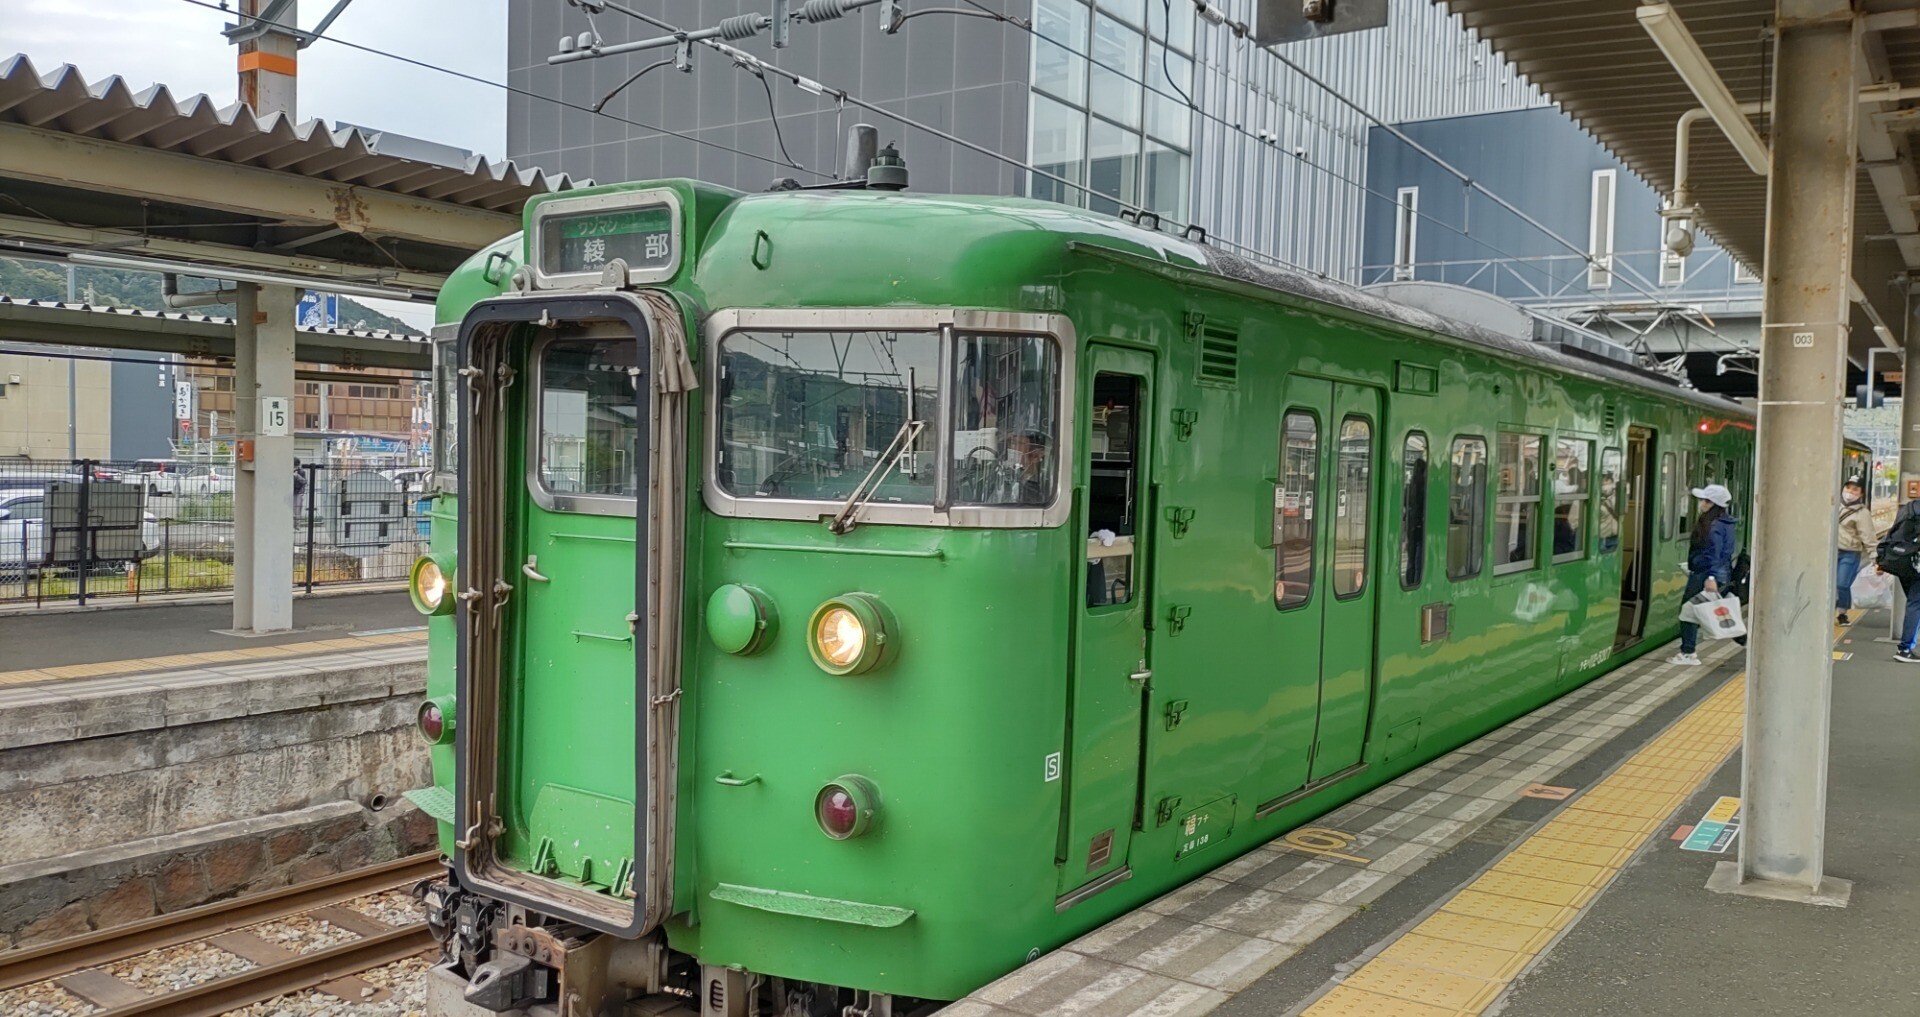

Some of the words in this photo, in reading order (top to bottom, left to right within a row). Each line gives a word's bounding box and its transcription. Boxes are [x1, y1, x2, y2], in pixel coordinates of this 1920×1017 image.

[577, 221, 618, 236] ワンマン
[1795, 335, 1812, 345] 003
[270, 411, 284, 427] 15
[1048, 758, 1057, 776] S
[1284, 826, 1357, 851] 6
